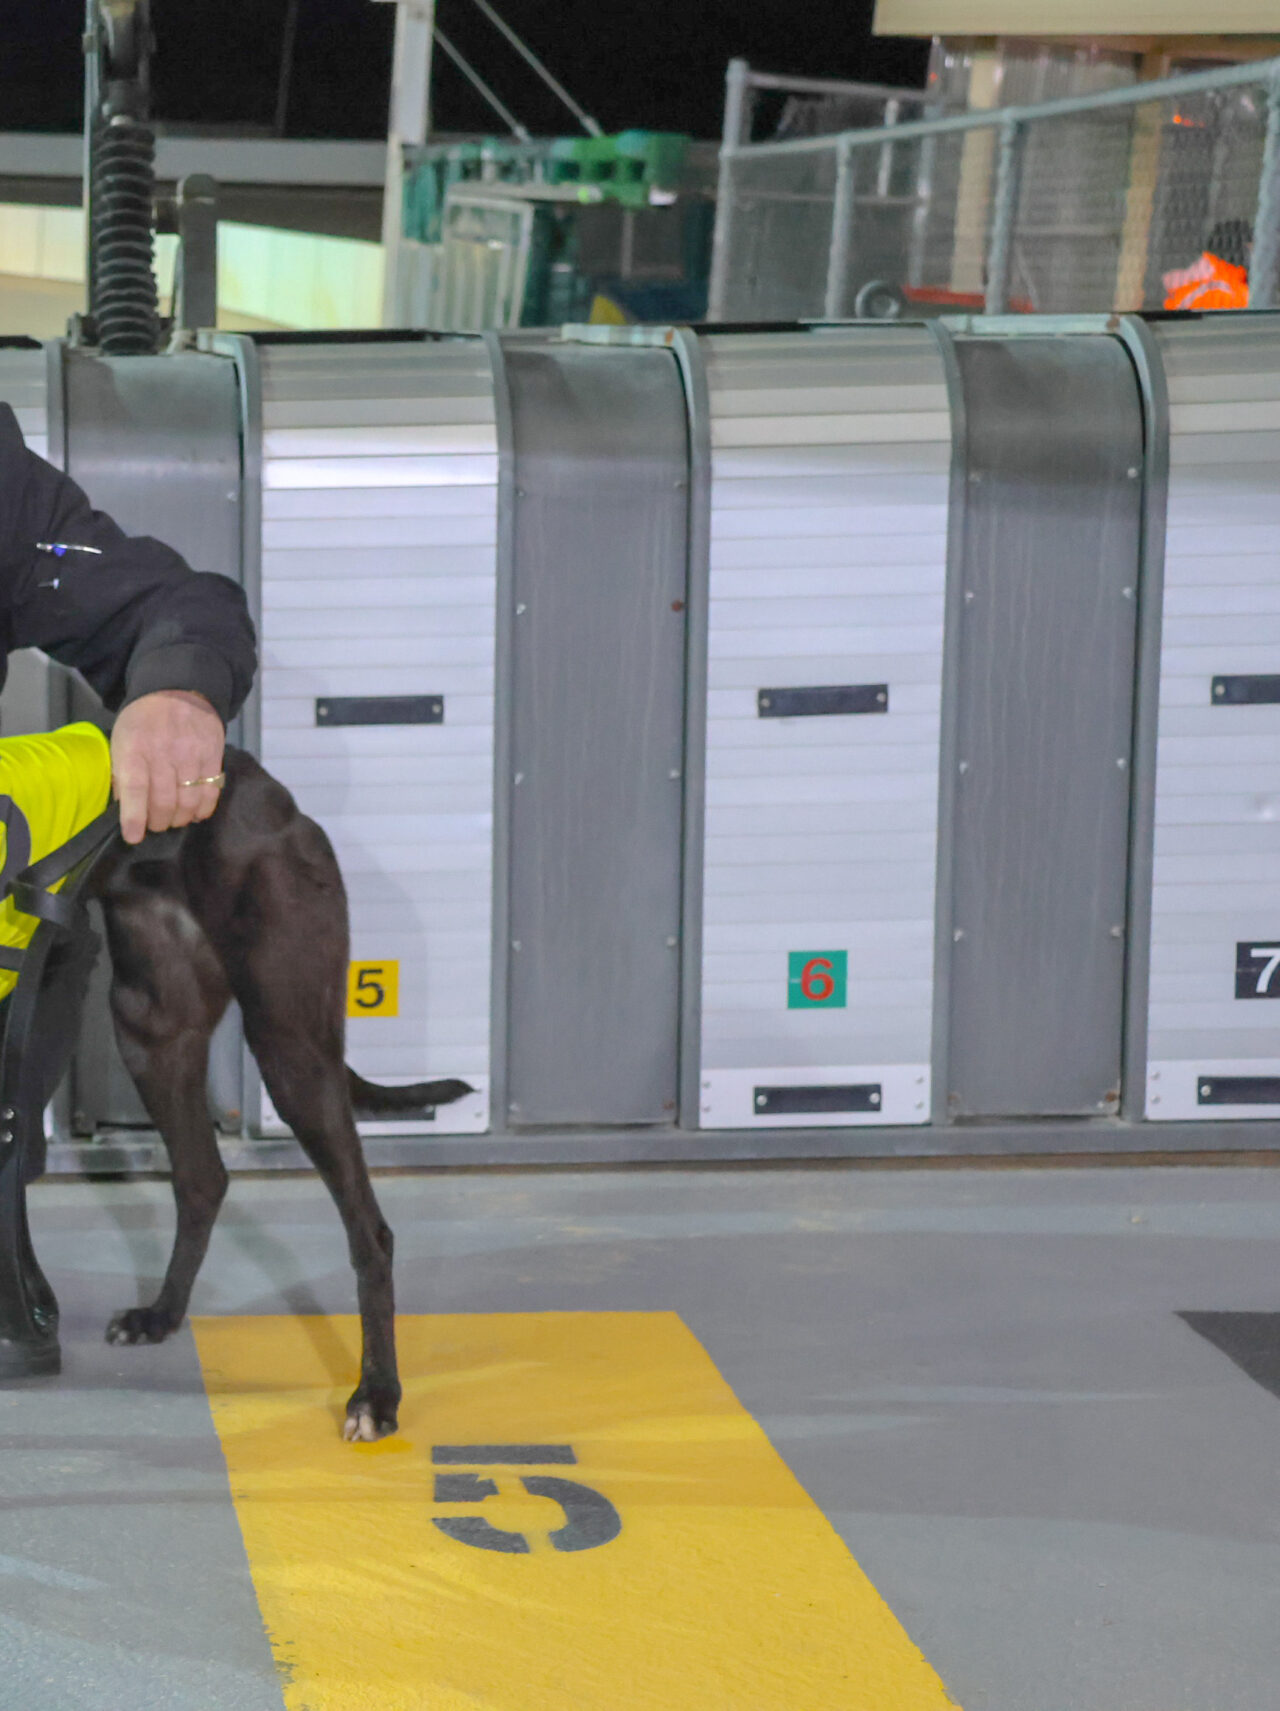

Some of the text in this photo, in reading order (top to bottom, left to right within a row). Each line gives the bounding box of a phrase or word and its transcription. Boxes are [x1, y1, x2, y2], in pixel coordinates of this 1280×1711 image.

[355, 968, 385, 1009] 5
[801, 957, 835, 1001] 6
[1250, 948, 1280, 993] 7
[431, 1444, 622, 1554] 5
